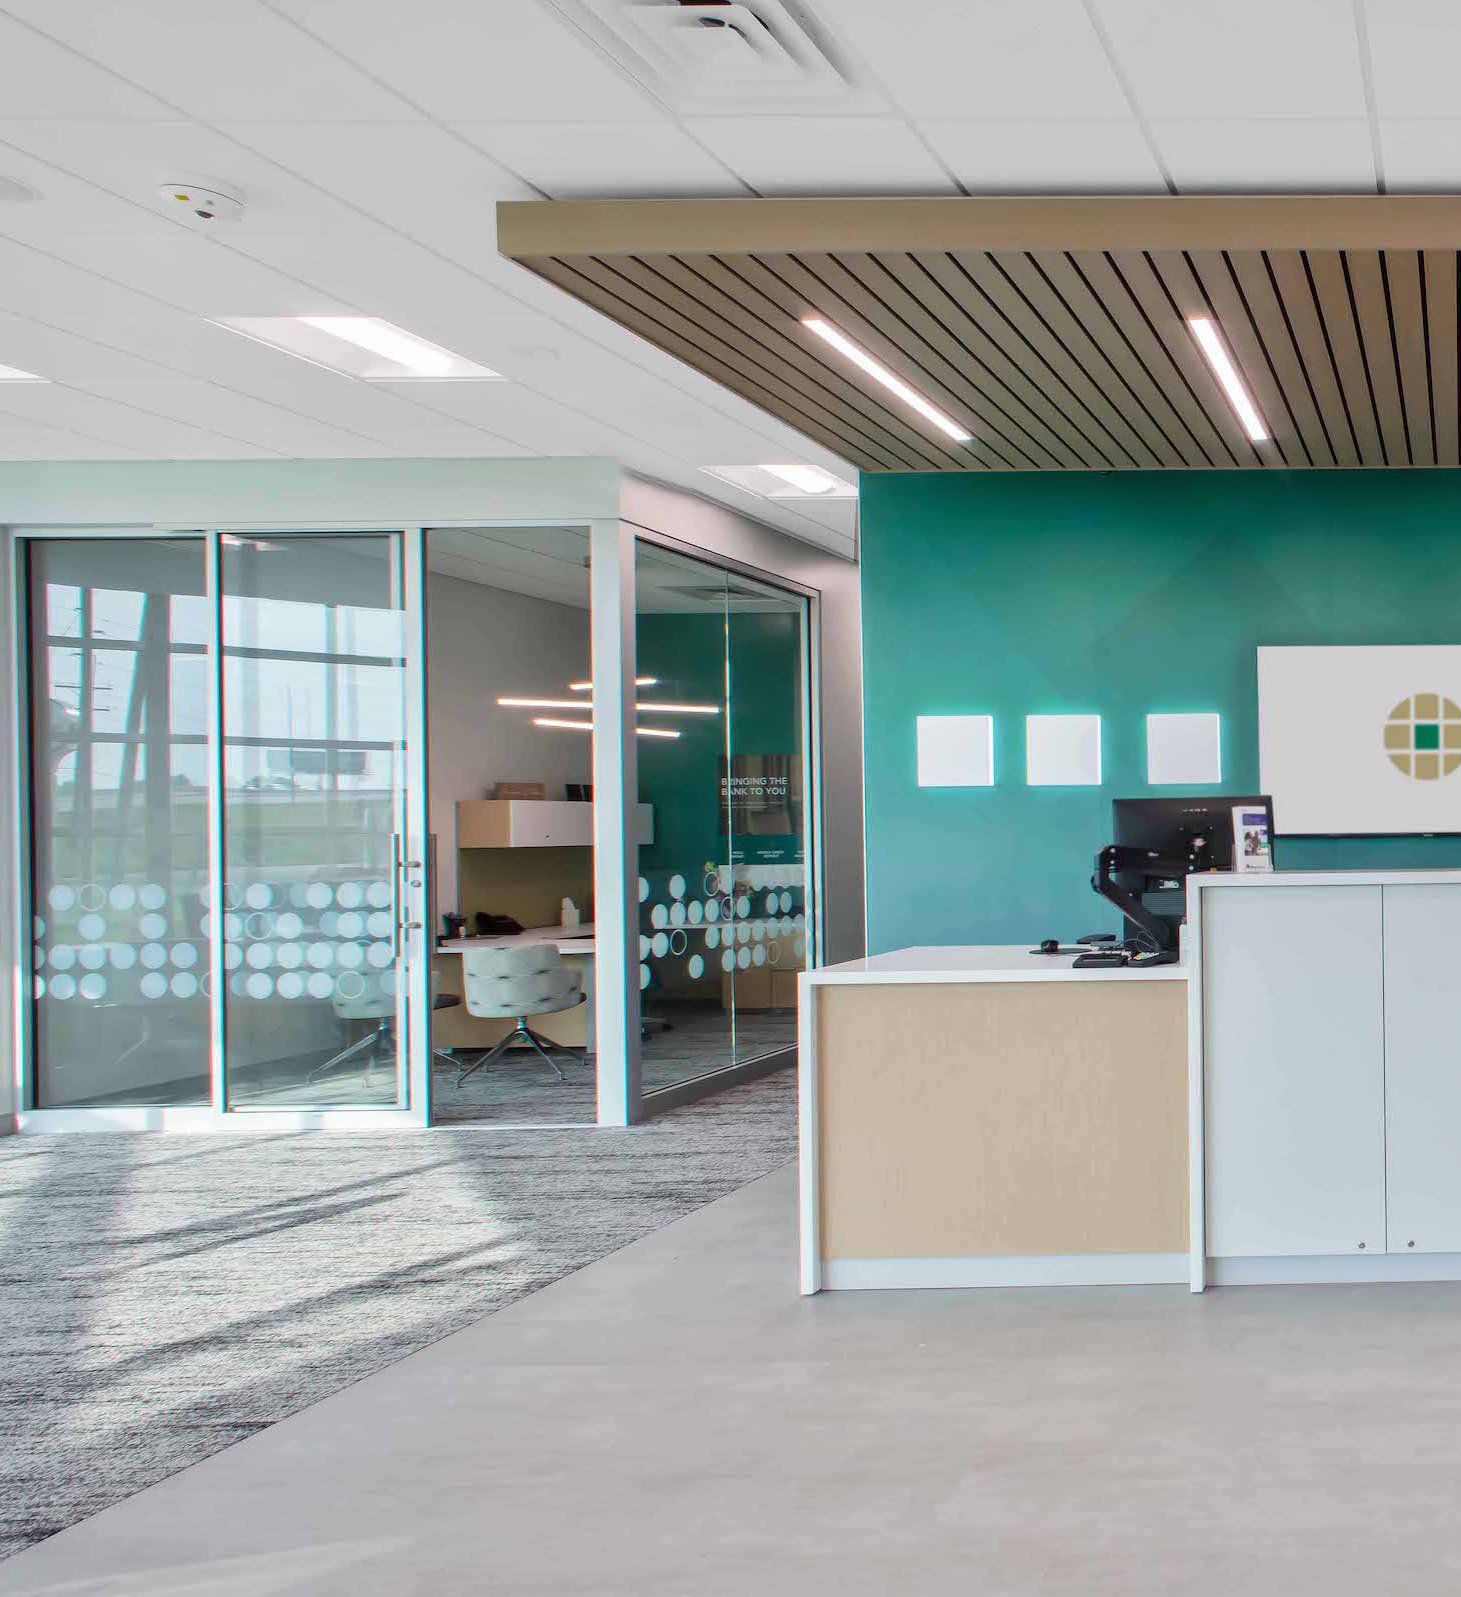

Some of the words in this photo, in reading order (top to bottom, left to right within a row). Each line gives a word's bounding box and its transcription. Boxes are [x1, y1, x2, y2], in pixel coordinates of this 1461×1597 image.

[769, 777, 788, 785] THE
[750, 787, 764, 795] TO
[766, 787, 786, 795] YOU
